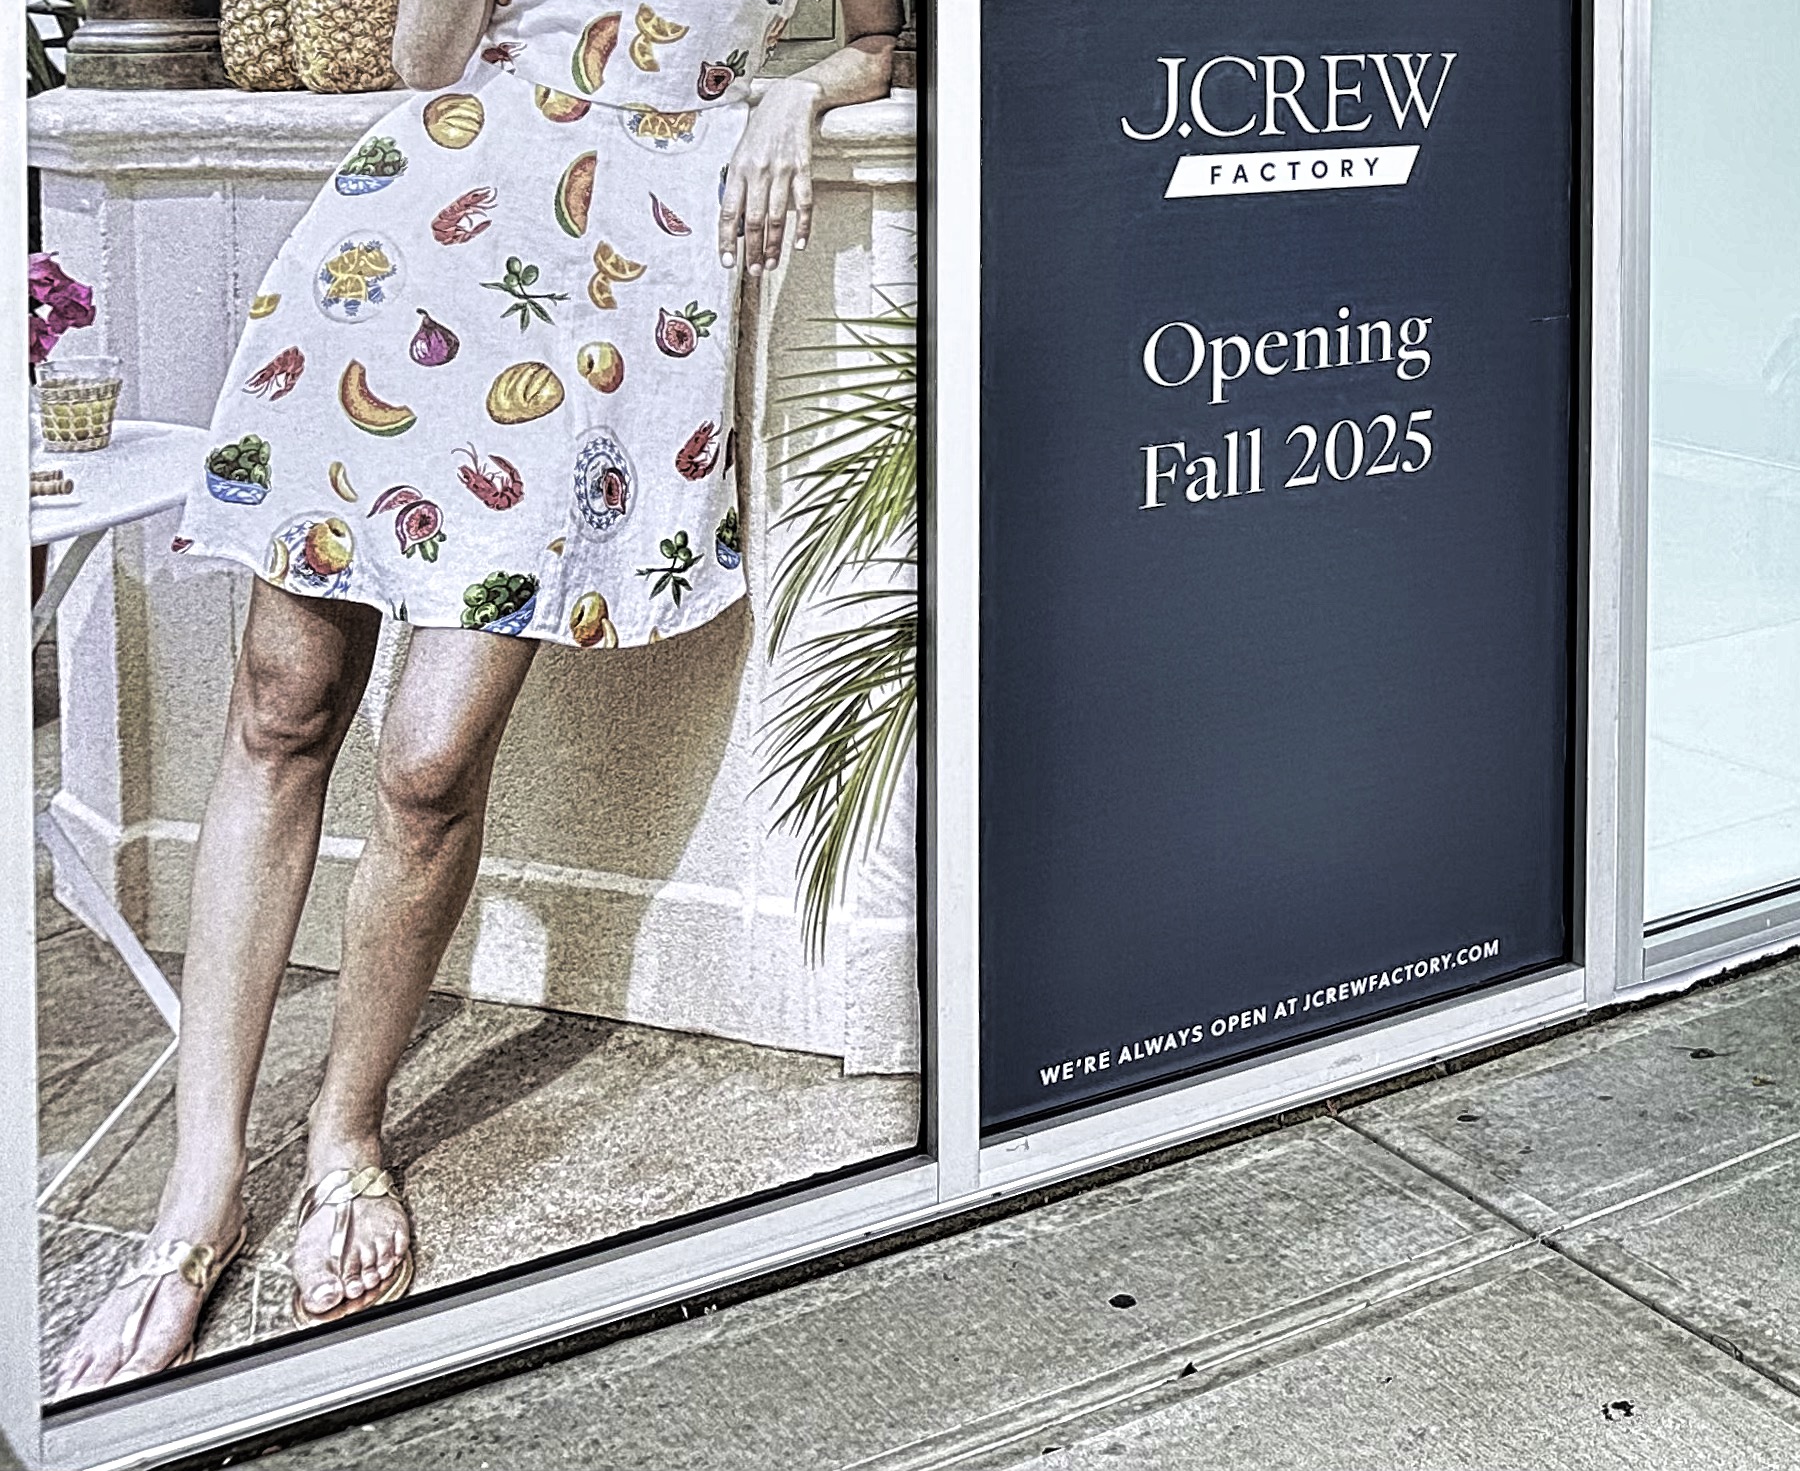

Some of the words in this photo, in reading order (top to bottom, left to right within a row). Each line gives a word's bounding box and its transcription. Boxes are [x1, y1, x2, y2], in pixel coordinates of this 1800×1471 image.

[1120, 52, 1458, 141] J.CREW
[1209, 157, 1381, 185] FACTORY
[1142, 306, 1433, 405] Opening
[1138, 427, 1266, 511] Fall
[1284, 409, 1433, 489] 2025
[1039, 1050, 1111, 1086] WE'RE
[1118, 1025, 1204, 1064] ALWAYS
[1210, 1005, 1268, 1038] OPEN
[1274, 998, 1299, 1019] AT
[1302, 939, 1500, 1012] JCREWFACTORY.COM
